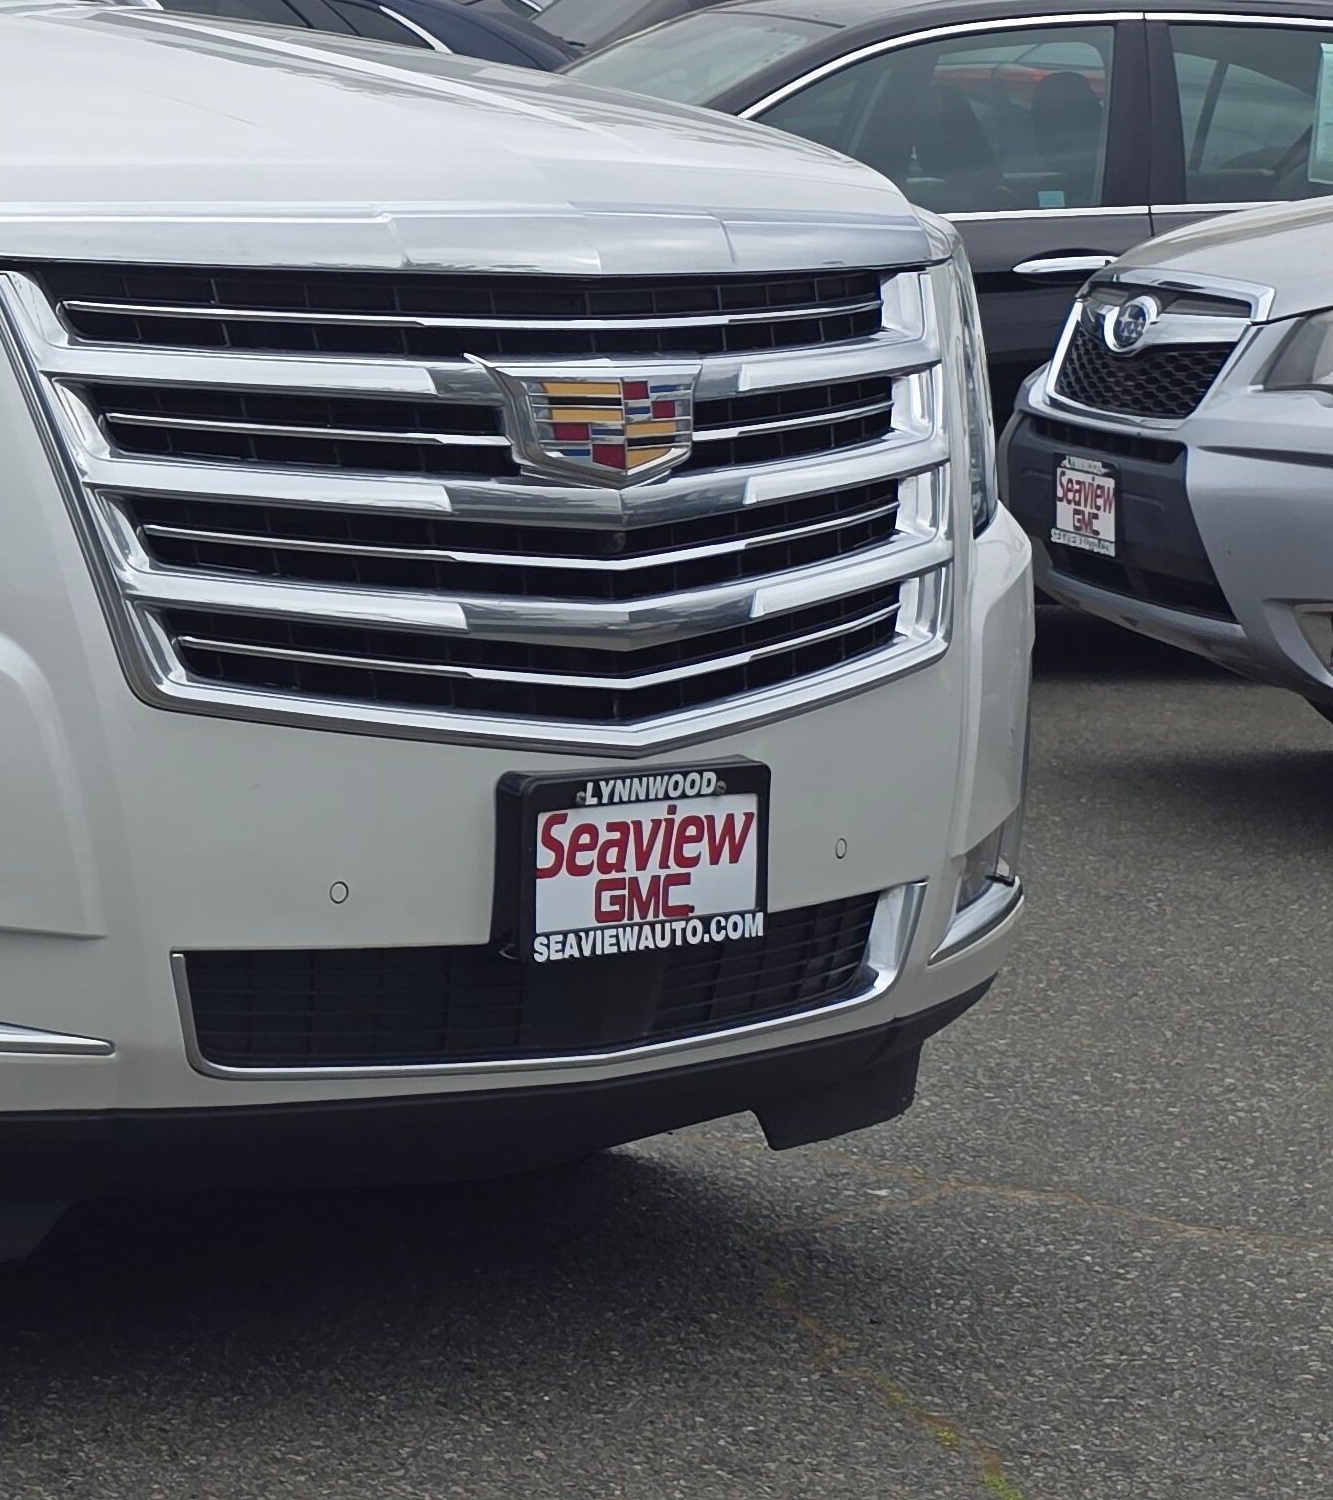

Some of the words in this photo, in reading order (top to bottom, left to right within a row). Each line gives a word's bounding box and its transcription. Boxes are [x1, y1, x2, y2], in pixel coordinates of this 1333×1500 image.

[1056, 470, 1115, 514] Seaview
[1073, 508, 1100, 536] GMC
[584, 771, 717, 805] LYNNWOOD
[536, 804, 755, 879] Seaview
[594, 872, 693, 924] GMC
[533, 912, 764, 963] SEAVIEWAUTO.COM
